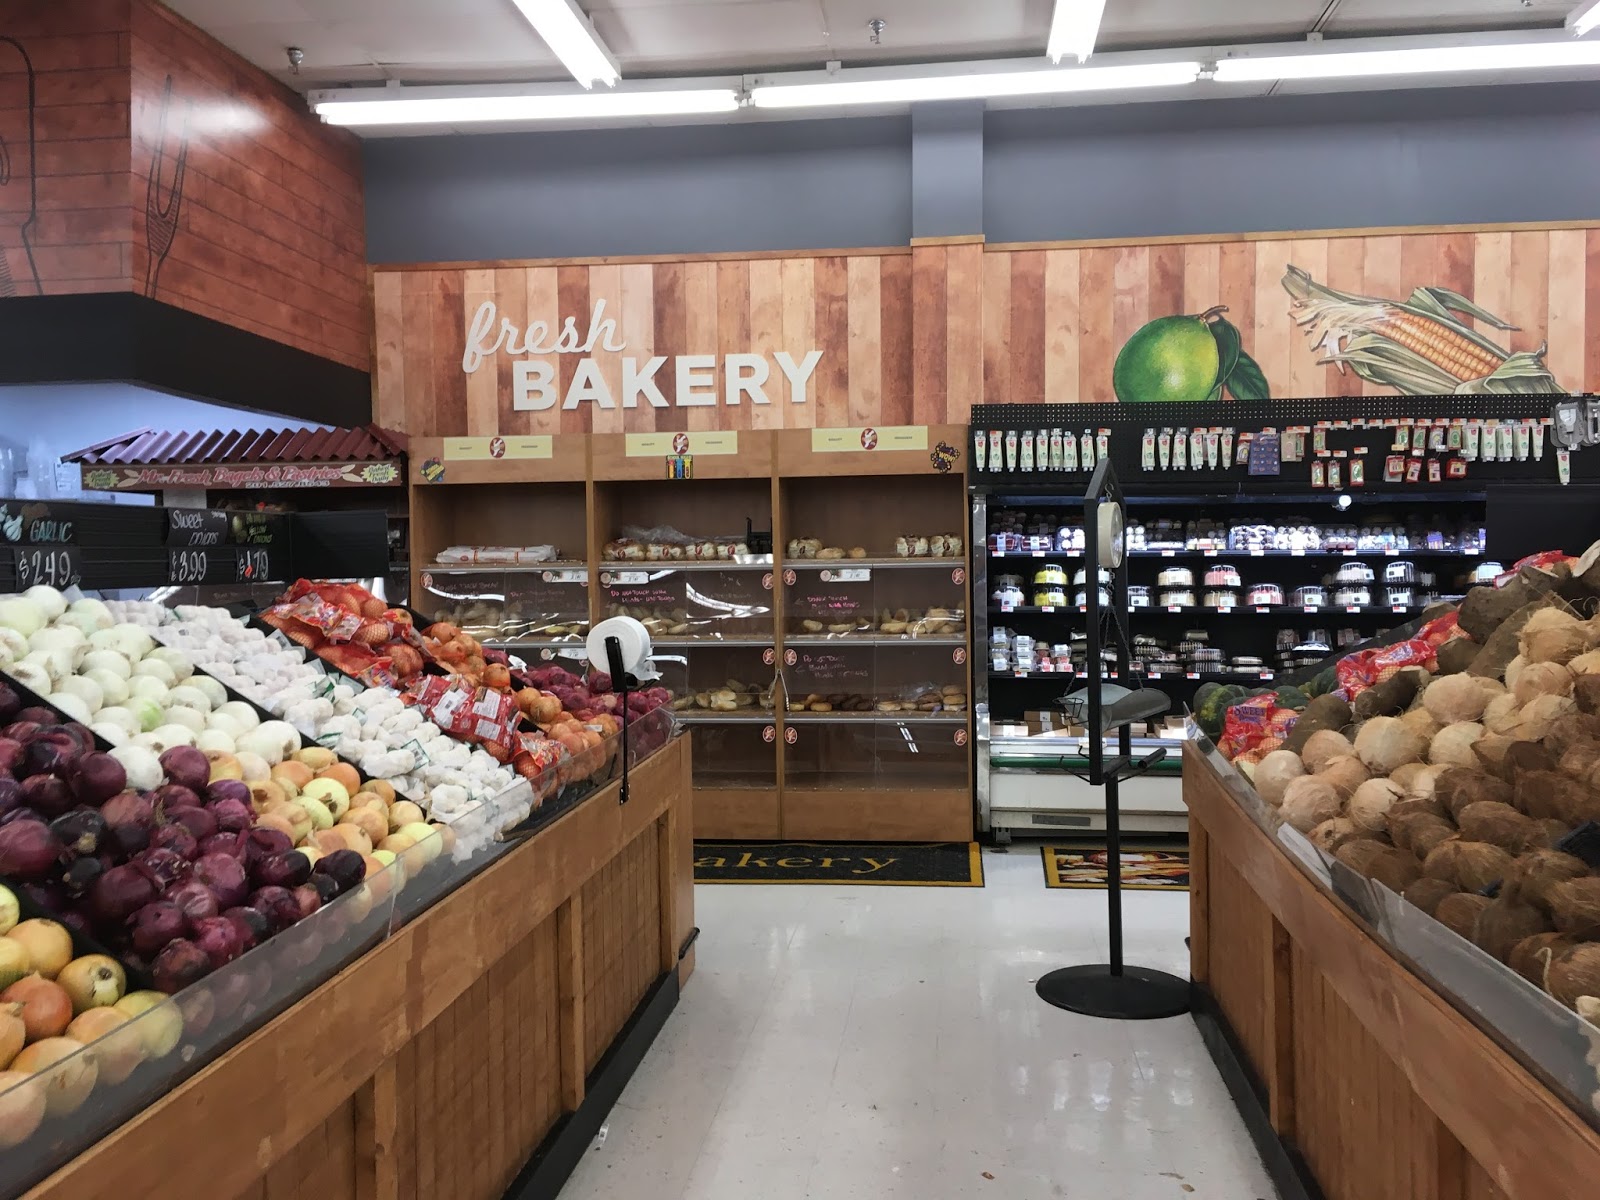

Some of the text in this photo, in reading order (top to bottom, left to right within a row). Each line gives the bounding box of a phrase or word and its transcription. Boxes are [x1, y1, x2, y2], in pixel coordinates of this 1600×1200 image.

[463, 299, 627, 374] fresh
[512, 350, 824, 411] BAKERY
[166, 468, 212, 486] Fresh
[213, 466, 264, 487] Bagels
[264, 467, 281, 482] &
[281, 465, 343, 483] Pastries
[172, 509, 204, 529] Sweet
[30, 519, 73, 542] GARLIC
[694, 852, 900, 873] akery
